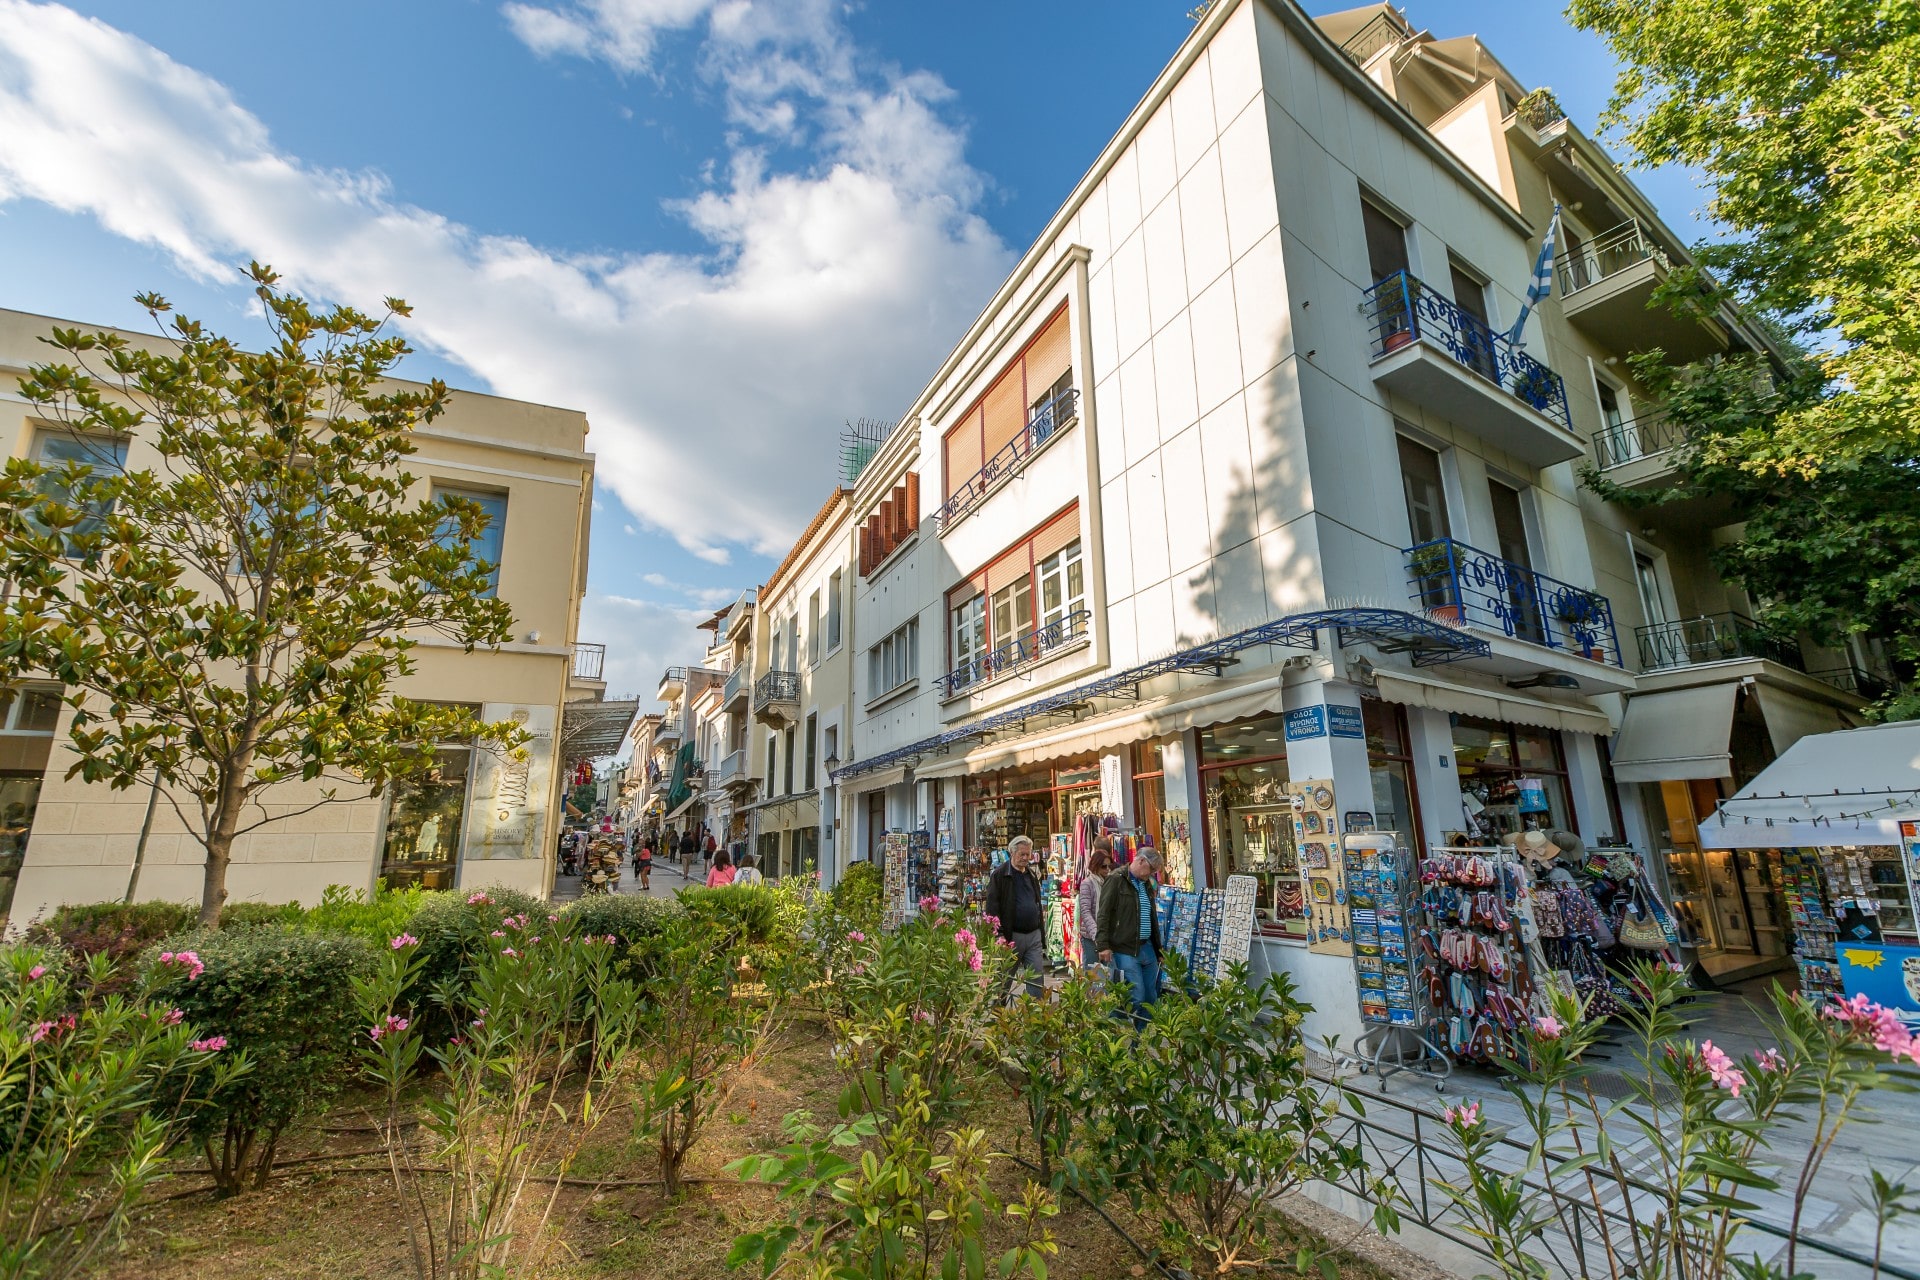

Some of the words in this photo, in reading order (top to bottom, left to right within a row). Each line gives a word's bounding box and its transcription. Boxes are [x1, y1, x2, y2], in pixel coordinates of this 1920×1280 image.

[1293, 709, 1314, 719] ΟΔΟΣ
[1289, 716, 1319, 728] ΒΥΡΩΝΟΣ
[1289, 725, 1320, 736] VYRONOS
[1302, 868, 1308, 880] 3
[1625, 927, 1658, 940] GREECE
